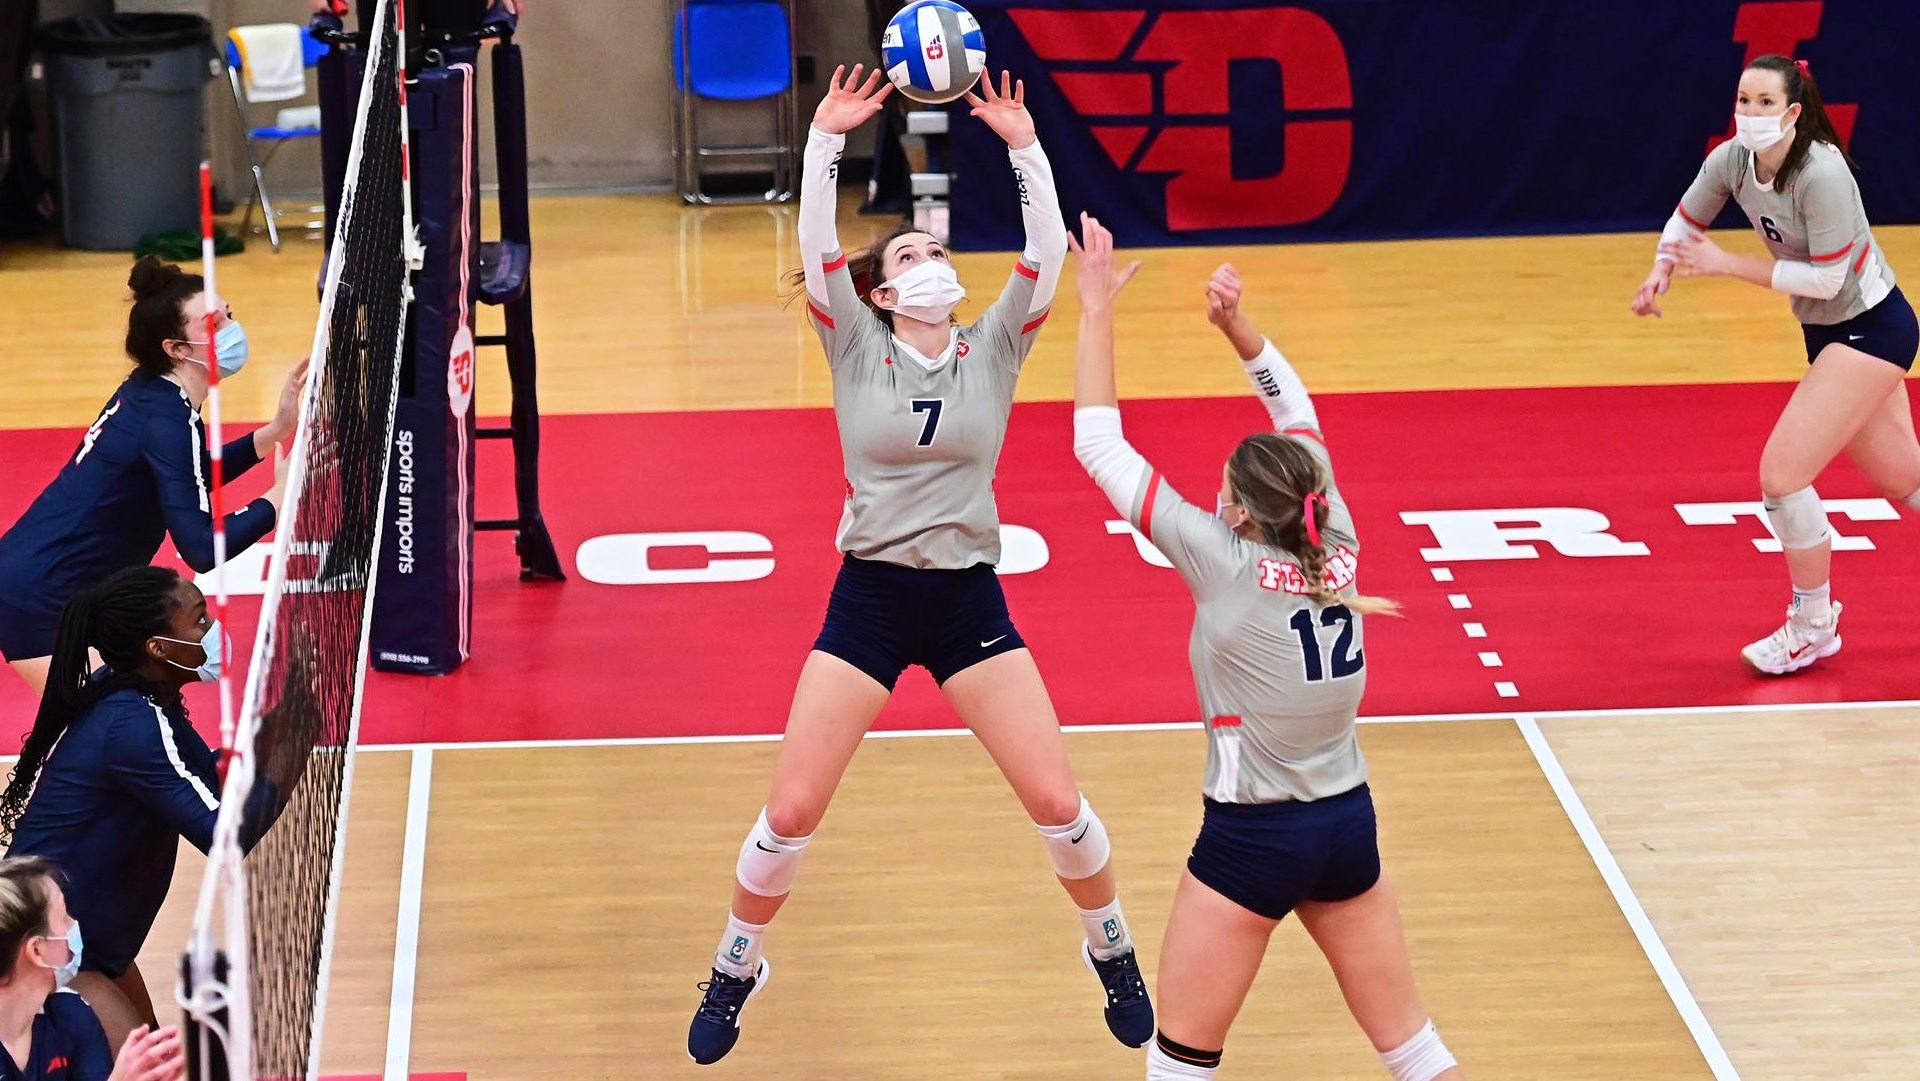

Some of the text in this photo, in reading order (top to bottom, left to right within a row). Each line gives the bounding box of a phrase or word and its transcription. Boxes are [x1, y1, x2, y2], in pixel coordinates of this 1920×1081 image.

[1759, 214, 1785, 246] 6
[910, 398, 944, 448] 7
[395, 429, 415, 574] sports imports
[1287, 601, 1365, 684] 12
